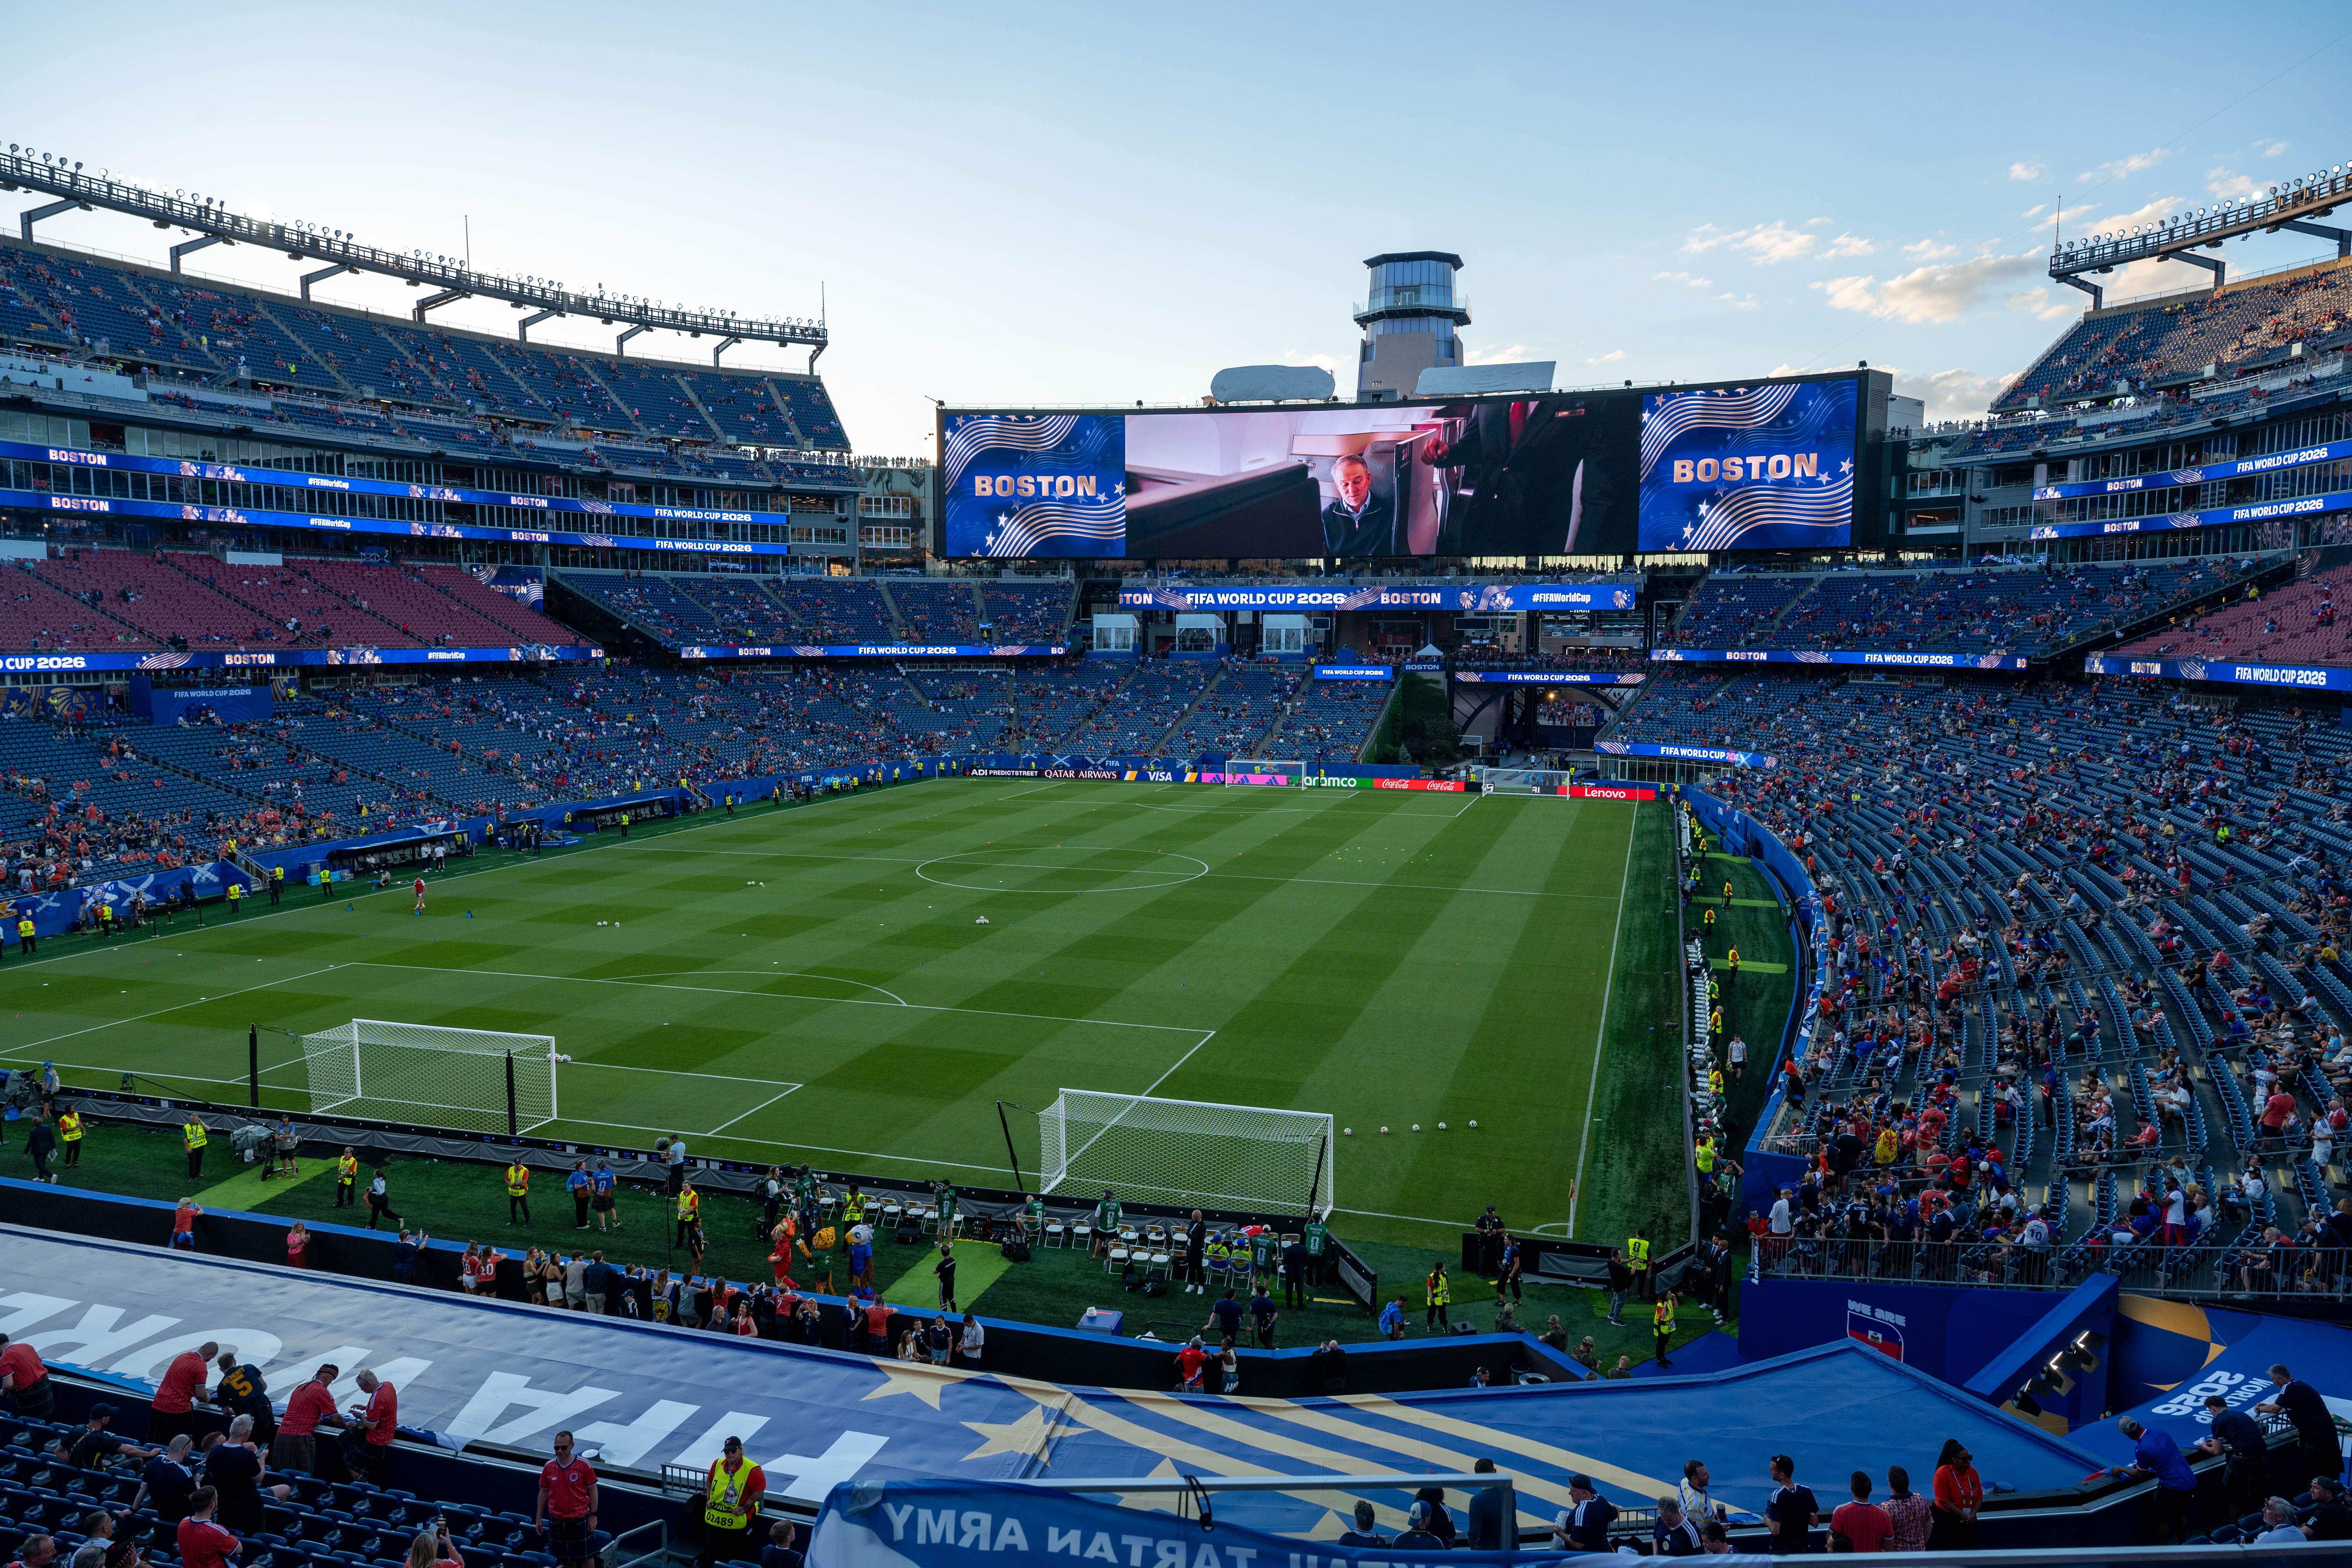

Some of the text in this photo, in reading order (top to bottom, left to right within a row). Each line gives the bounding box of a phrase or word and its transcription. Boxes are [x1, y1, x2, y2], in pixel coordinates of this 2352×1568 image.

[49, 449, 107, 466] BOSTON
[2237, 448, 2327, 473] FIFA WORLD CUP 2026
[1673, 453, 1818, 483] BOSTON
[308, 478, 349, 490] #FIFAWorldCup
[975, 476, 1096, 497] BOSTON
[2107, 479, 2142, 491] BOSTON
[52, 497, 109, 511] BOSTON
[511, 496, 548, 507] BOSTON
[655, 509, 751, 521] FIFA WORLD CUP 2026
[2233, 499, 2323, 520] FIFA WORLD CUP 2026
[310, 518, 351, 529] #FIFAWorldCup
[2104, 521, 2139, 532] BOSTON
[512, 532, 548, 542] BOSTON
[674, 542, 704, 550] WORLD
[1187, 593, 1346, 605] FIFA WORLD CUP 2026
[1381, 593, 1440, 604] BOSTON
[1532, 593, 1591, 604] #FIFAWorldCup
[428, 652, 465, 660] #FIFAWorldCup
[592, 649, 604, 657] BO
[1726, 652, 1767, 660] BOSTON
[1865, 654, 1954, 664] FIFA WORLD CUP 2026
[6, 658, 35, 670] CUP
[37, 657, 85, 669] 2026
[226, 654, 275, 665] BOSTON
[2017, 658, 2028, 668] BO
[2132, 662, 2161, 674] BOSTON
[2235, 667, 2326, 686] FIFA WORLD CUP 2026
[1661, 747, 1679, 755] FIFA
[1680, 748, 1708, 758] WORLD
[1709, 751, 1726, 759] CUP
[1045, 769, 1117, 779] QATAR AIRWAYS
[1146, 771, 1172, 781] VISA
[1304, 777, 1356, 787] aramco
[1585, 788, 1626, 798] Lenovo
[1859, 1211, 1866, 1224] 4
[2030, 1229, 2042, 1241] 10
[777, 1299, 782, 1308] 7
[1848, 1299, 1906, 1327] WE ARE
[222, 1367, 245, 1386] HENDRY
[230, 1374, 253, 1396] 5
[2151, 1370, 2245, 1416] 2026
[706, 1511, 733, 1526] 02489
